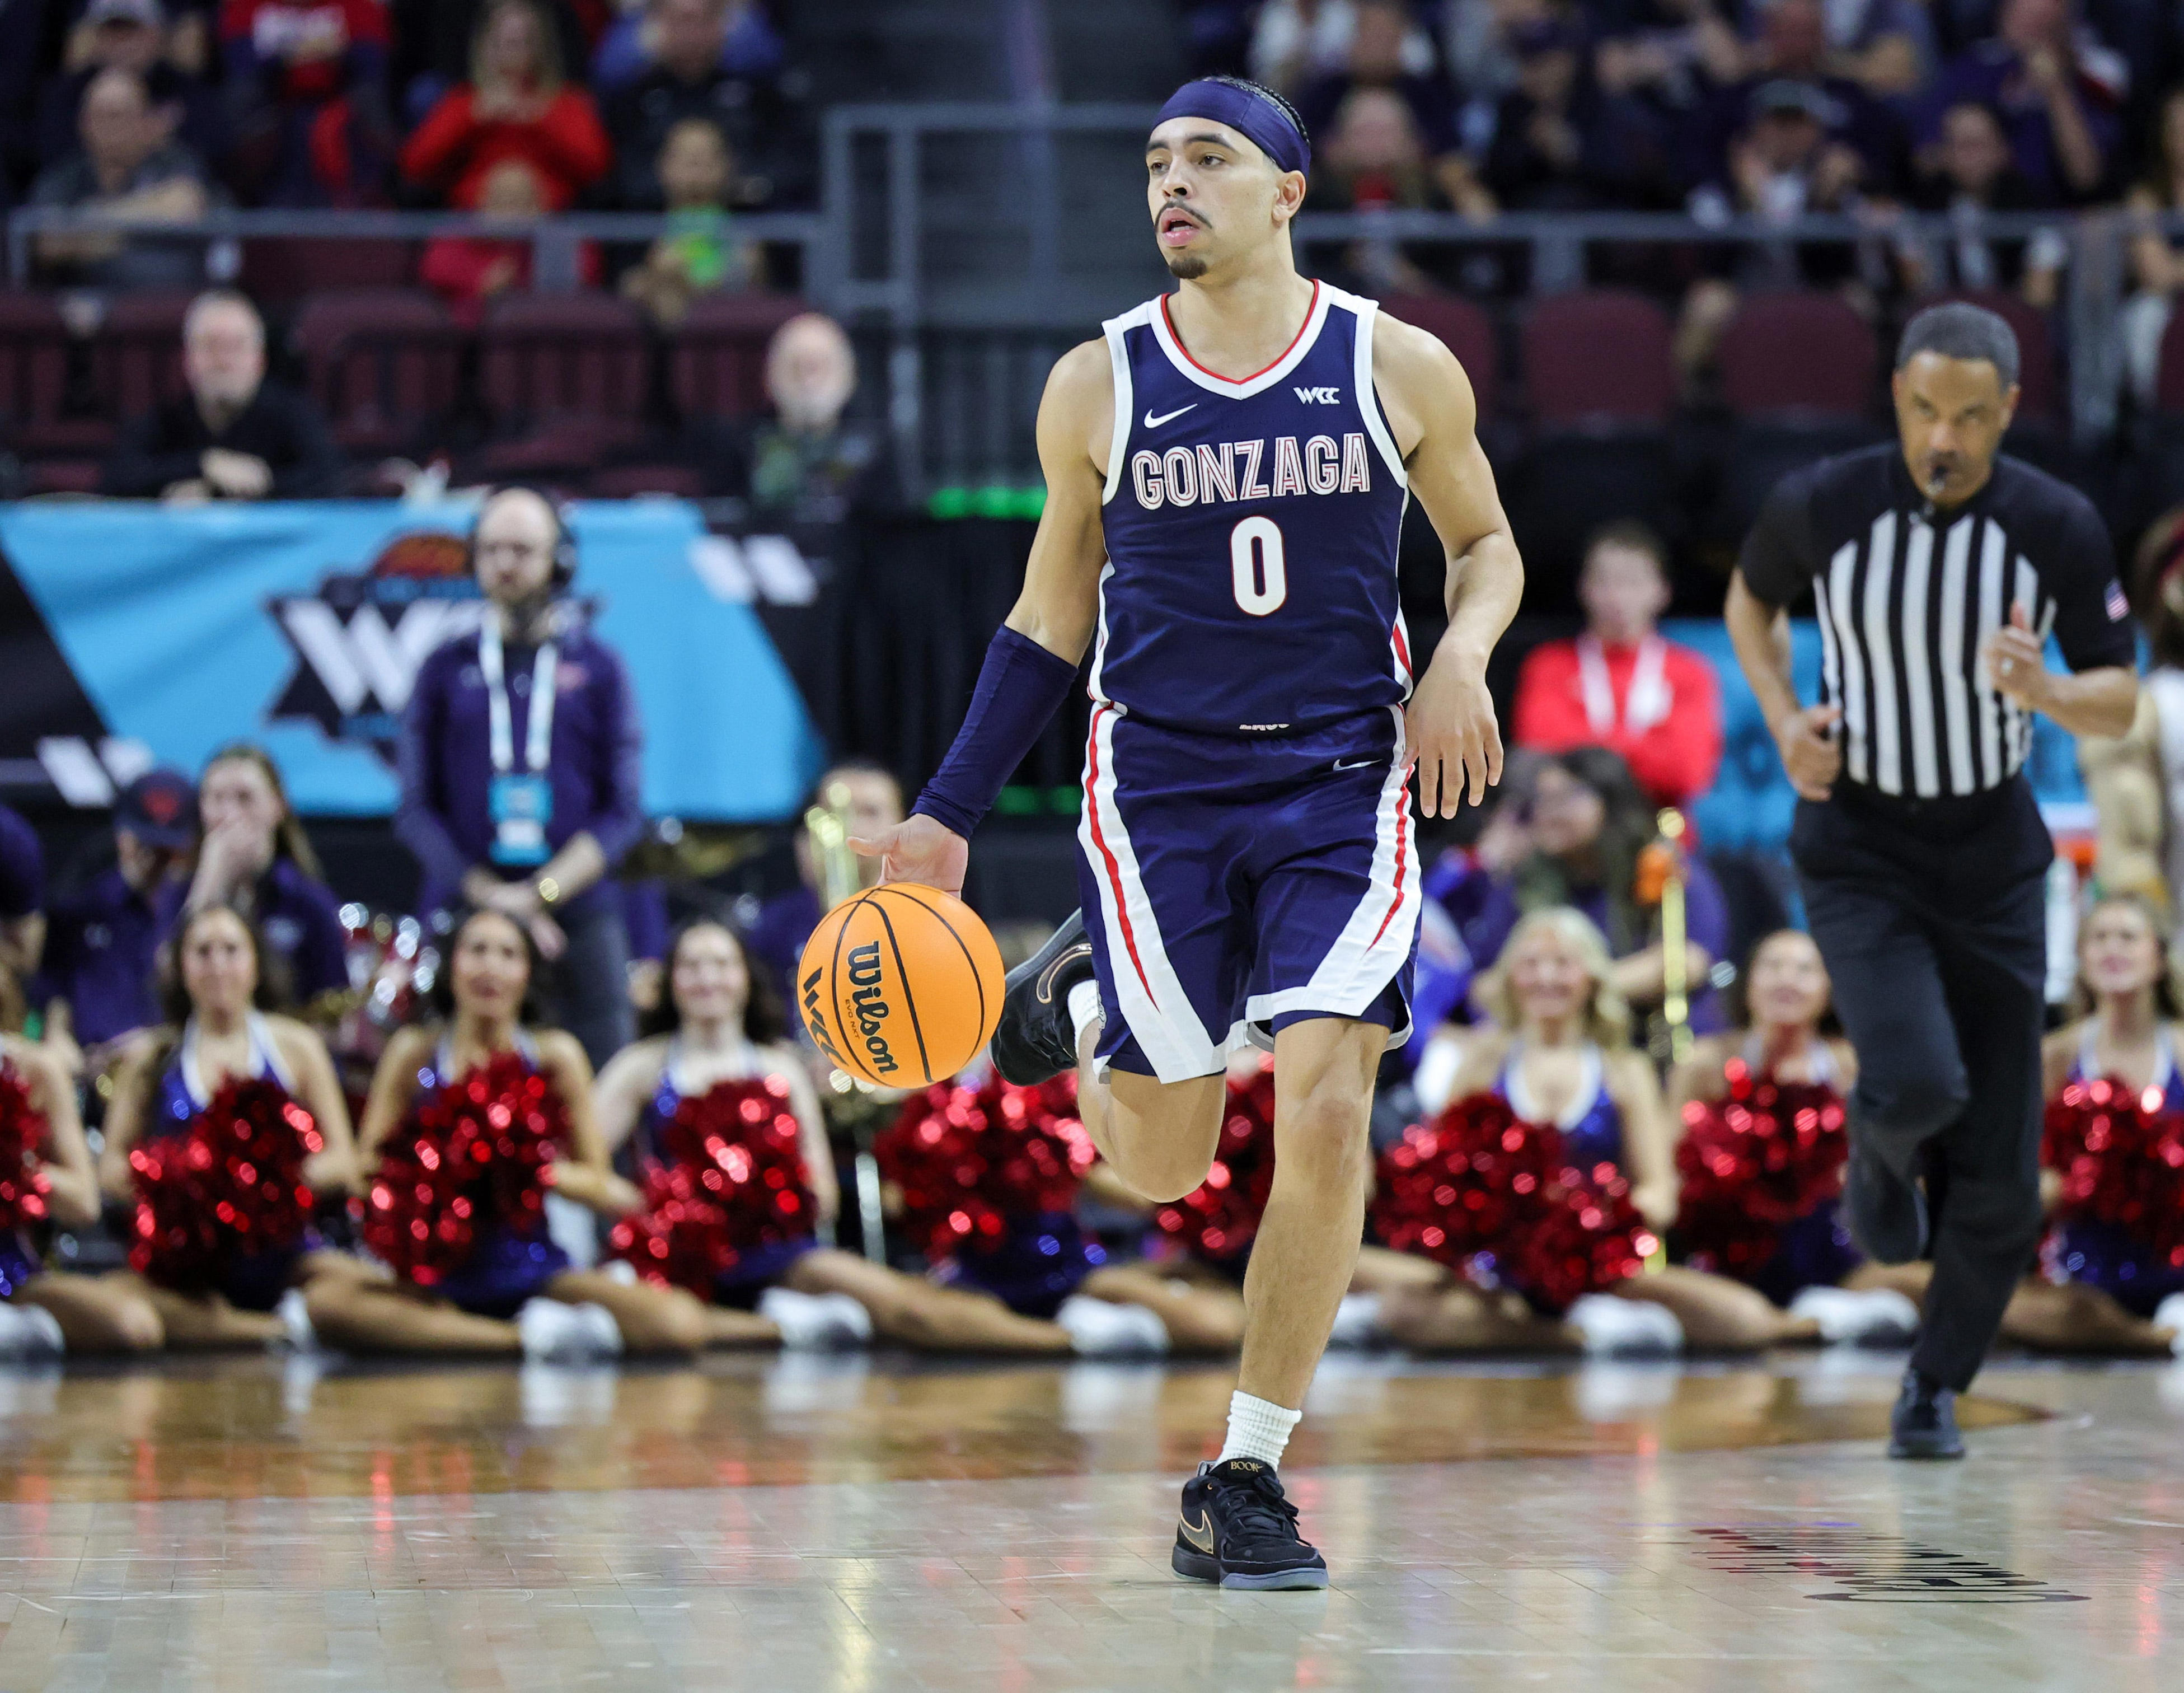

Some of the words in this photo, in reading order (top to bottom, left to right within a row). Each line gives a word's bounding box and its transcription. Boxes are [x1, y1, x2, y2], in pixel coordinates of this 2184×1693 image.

[1293, 387, 1341, 405] WCC
[1131, 432, 1371, 511] GONZAGA
[1229, 515, 1288, 617] 0
[803, 966, 850, 1067] WCC
[845, 999, 854, 1018] EVO
[850, 1021, 860, 1040] NXT
[847, 939, 899, 1075] Wilson
[1230, 1461, 1263, 1473] BOOK
